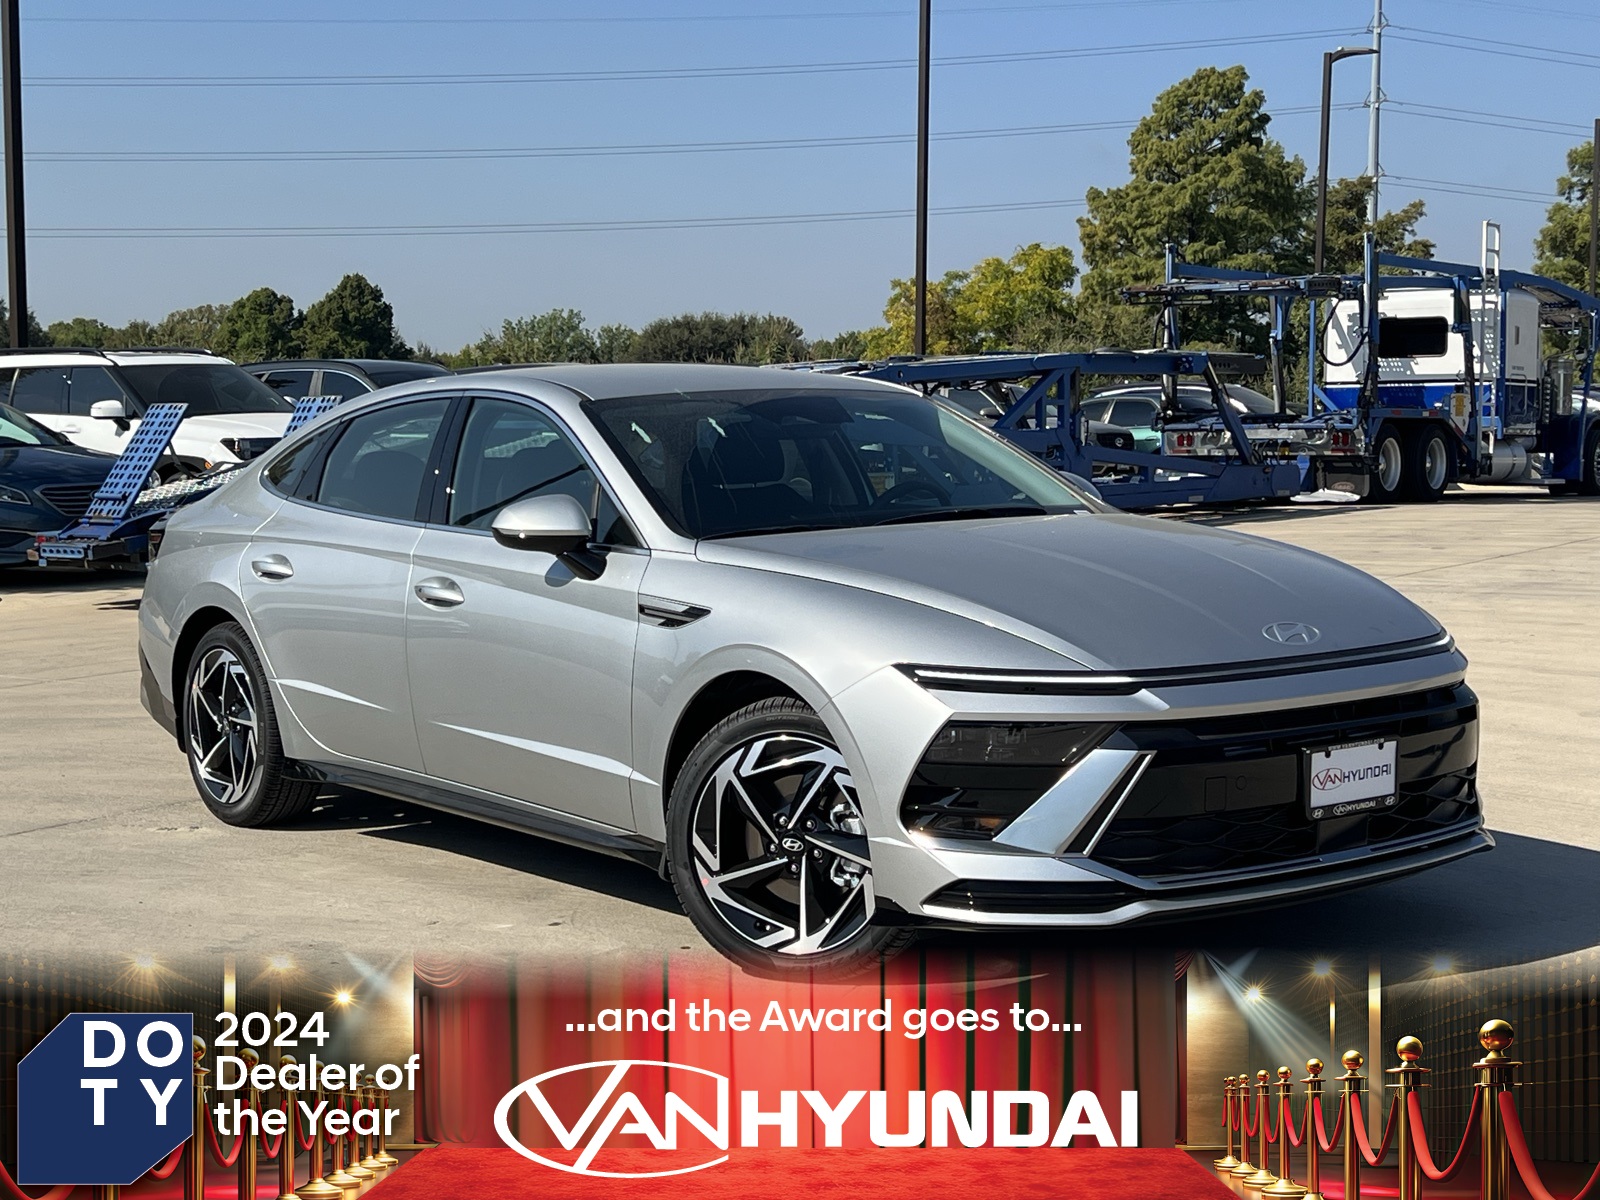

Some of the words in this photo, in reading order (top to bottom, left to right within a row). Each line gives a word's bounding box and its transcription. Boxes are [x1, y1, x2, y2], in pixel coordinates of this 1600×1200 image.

[1314, 768, 1342, 790] VAN
[1342, 763, 1392, 783] HYUNDAI
[1347, 800, 1376, 811] HYUNDAI
